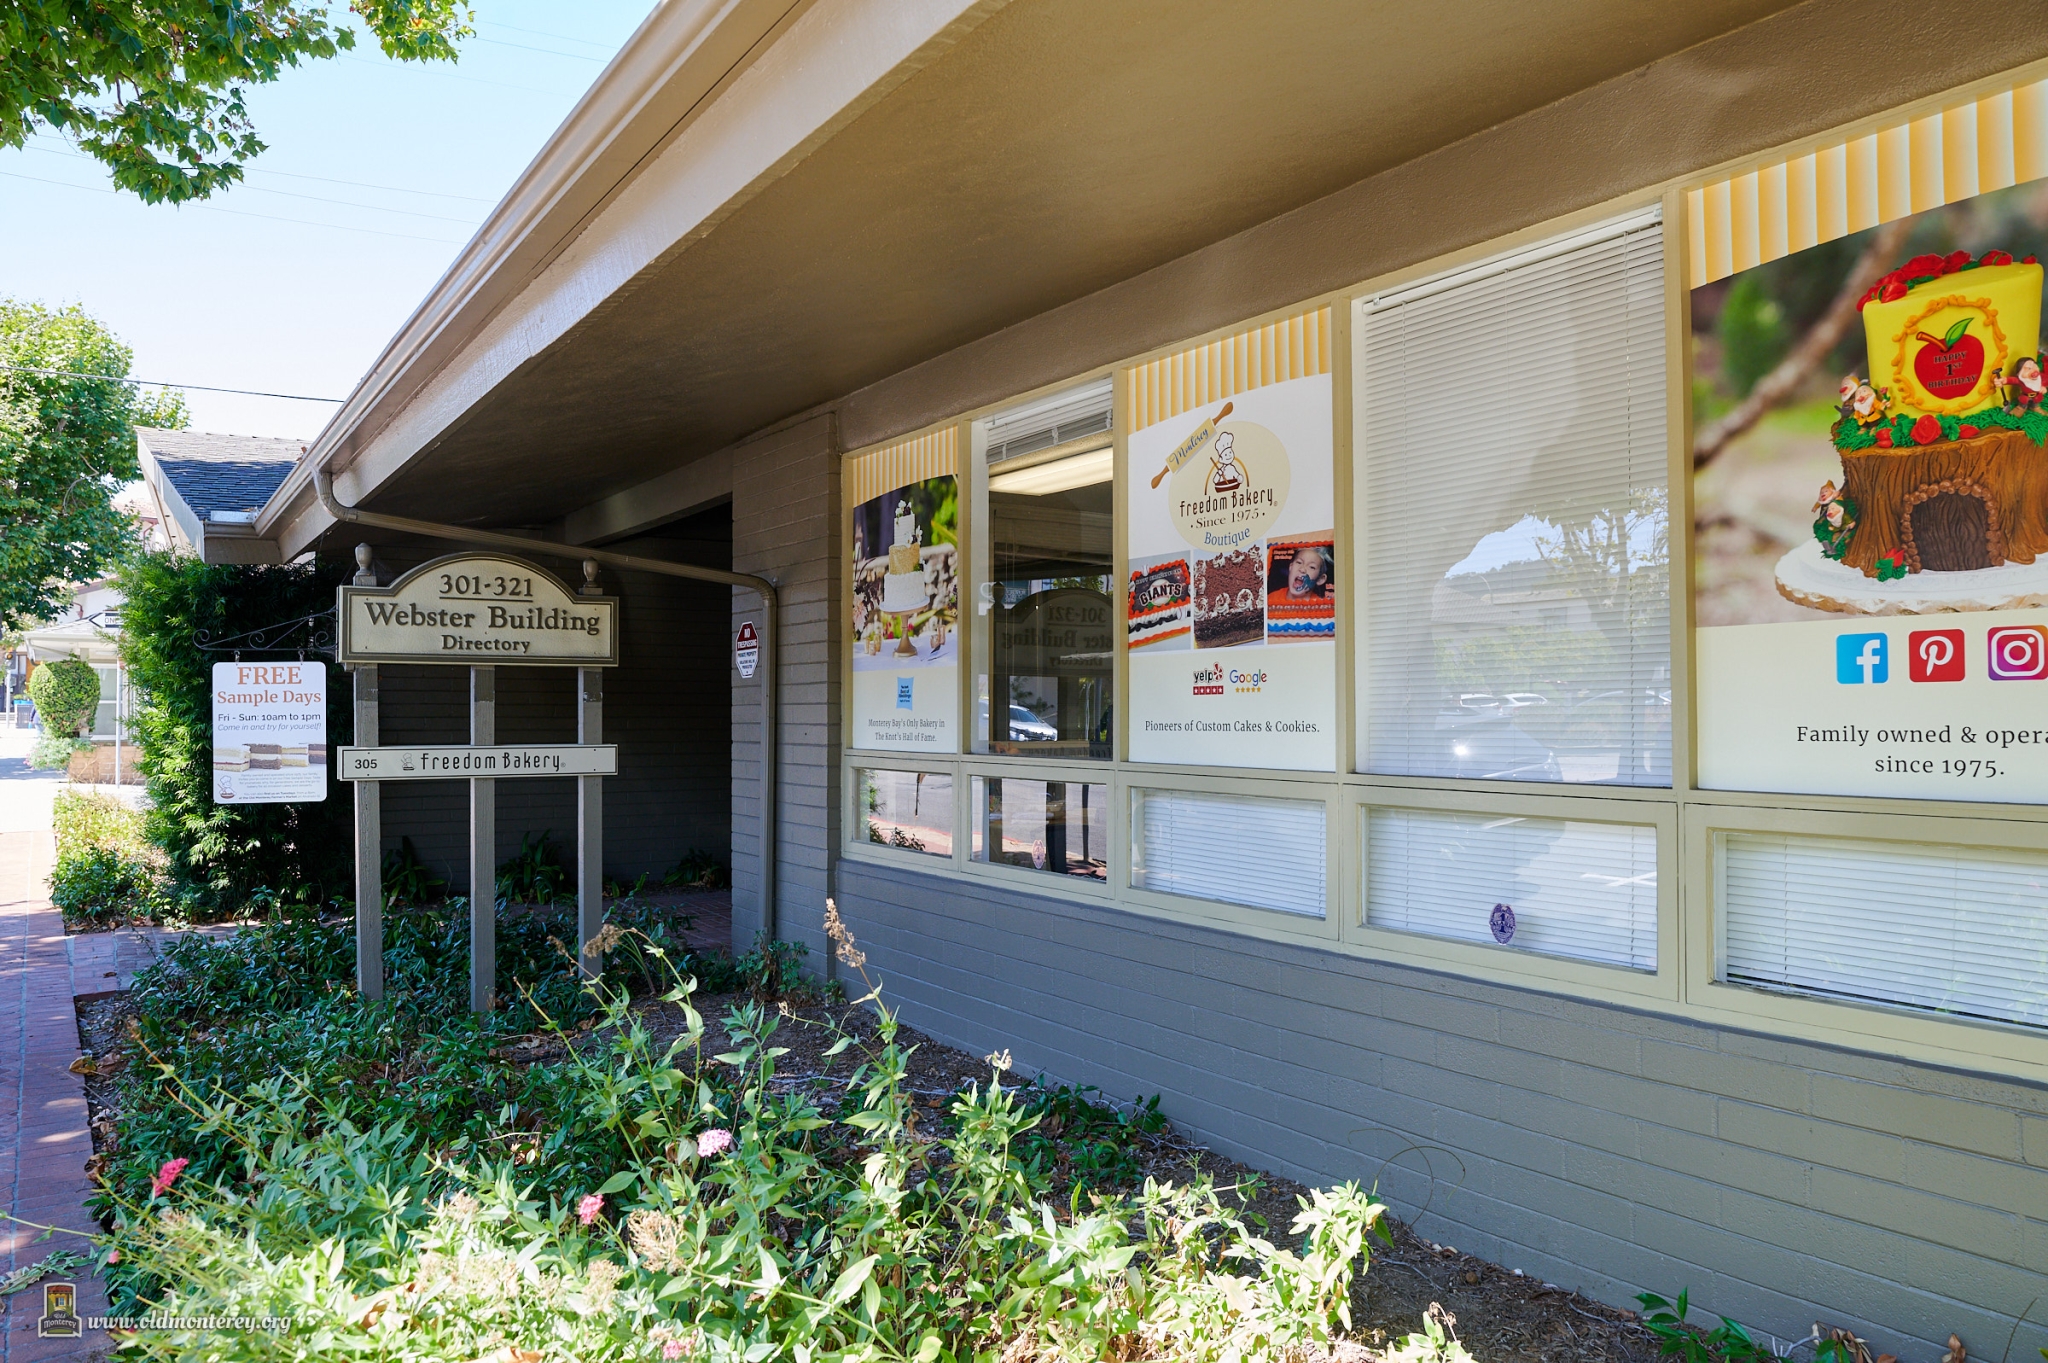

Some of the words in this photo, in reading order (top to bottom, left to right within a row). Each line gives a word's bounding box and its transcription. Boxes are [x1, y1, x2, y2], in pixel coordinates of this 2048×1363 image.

[1934, 352, 1967, 363] HAPPY
[1928, 375, 1977, 388] BIRTHDAY
[1169, 428, 1209, 465] Monterey
[1196, 516, 1227, 529] Since
[1232, 508, 1259, 524] 1975
[1204, 528, 1251, 547] Boutique
[439, 574, 534, 597] 301-321
[1139, 583, 1182, 605] GIANTS
[364, 602, 475, 628] Webster
[487, 605, 600, 636] Building
[441, 634, 530, 654] Directory
[237, 666, 302, 685] FREE
[1193, 669, 1214, 684] yelp
[1229, 669, 1267, 687] Google
[217, 690, 278, 707] Sample
[283, 690, 322, 706] Days
[218, 713, 230, 722] Fri
[239, 713, 260, 721] Sun:
[289, 713, 299, 721] to
[301, 713, 321, 722] 1pm
[868, 719, 892, 729] Monterey
[892, 718, 906, 729] Bay's
[906, 718, 919, 729] Only
[920, 718, 939, 729] Bakery
[939, 719, 945, 727] in
[1145, 720, 1182, 732] Pioneers
[1184, 720, 1194, 732] of
[1195, 720, 1231, 732] Custom
[1233, 720, 1262, 732] Cakes
[1265, 721, 1272, 732] &
[1275, 720, 1320, 733] Cookies.
[218, 724, 240, 732] Come
[241, 723, 249, 731] in
[250, 723, 266, 731] and
[266, 723, 277, 732] try
[277, 723, 288, 732] for
[290, 722, 322, 732] yourself!
[875, 732, 885, 741] The
[885, 732, 902, 741] Knot's
[902, 732, 914, 741] Hall
[914, 732, 920, 742] of
[920, 733, 937, 742] Fame.
[1797, 725, 1870, 747] Family
[1877, 725, 1952, 744] owned
[1961, 726, 1977, 744] &
[1985, 729, 2048, 748] oper
[354, 758, 378, 770] 305
[420, 752, 497, 770] freedom
[1875, 756, 1934, 773] since
[1942, 759, 2004, 778] 1975.
